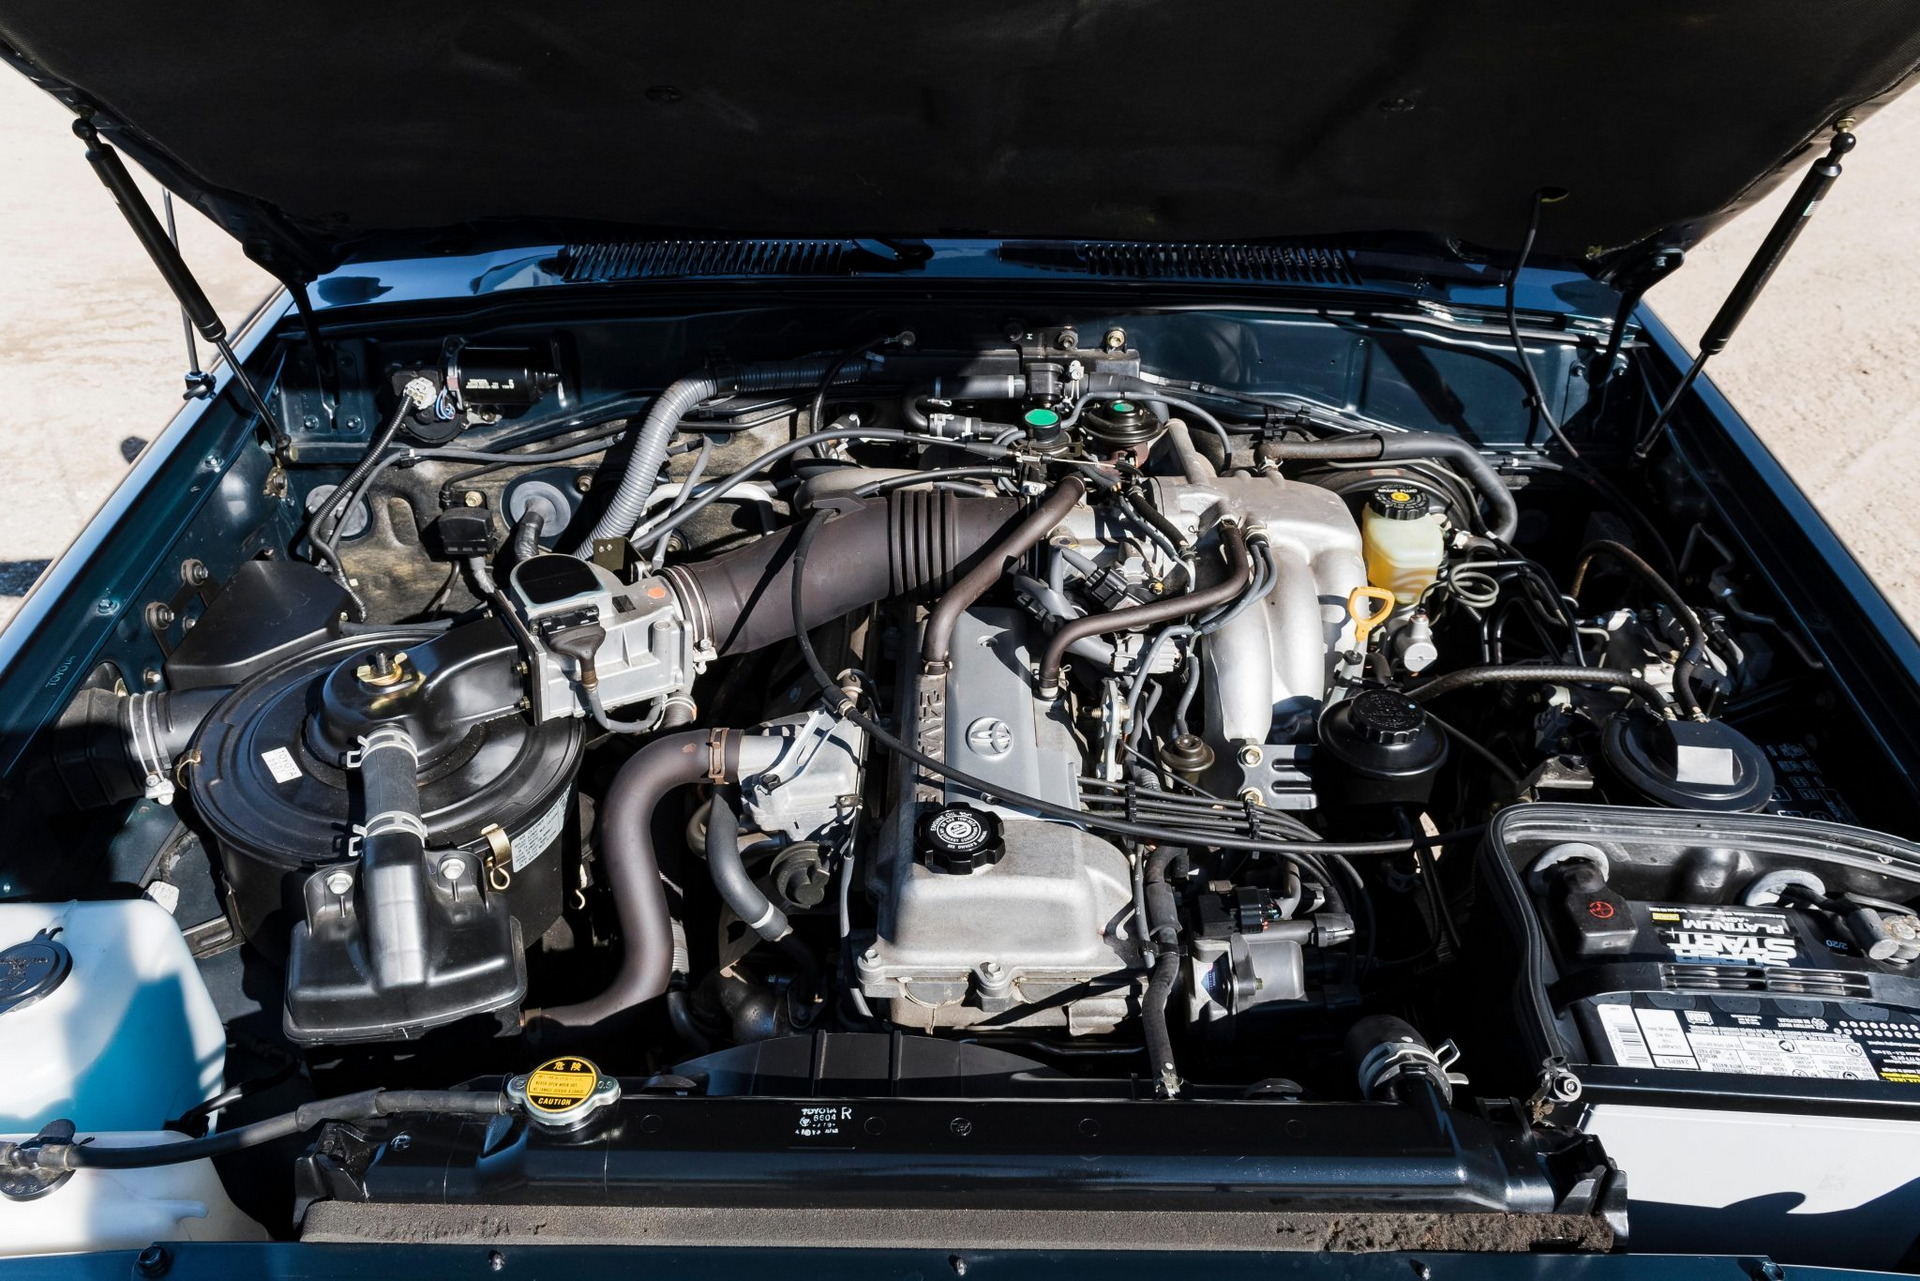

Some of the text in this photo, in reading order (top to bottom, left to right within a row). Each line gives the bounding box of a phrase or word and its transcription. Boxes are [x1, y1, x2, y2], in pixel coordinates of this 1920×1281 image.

[930, 815, 945, 831] ENGINE
[1682, 919, 1785, 935] PLATINUM
[1666, 932, 1797, 959] START
[1825, 939, 1849, 950] 2/20
[1675, 949, 1790, 967] SUPER
[553, 1061, 582, 1072] 危険
[538, 1097, 571, 1106] CAUTION
[801, 1106, 852, 1120] TOYOTA R
